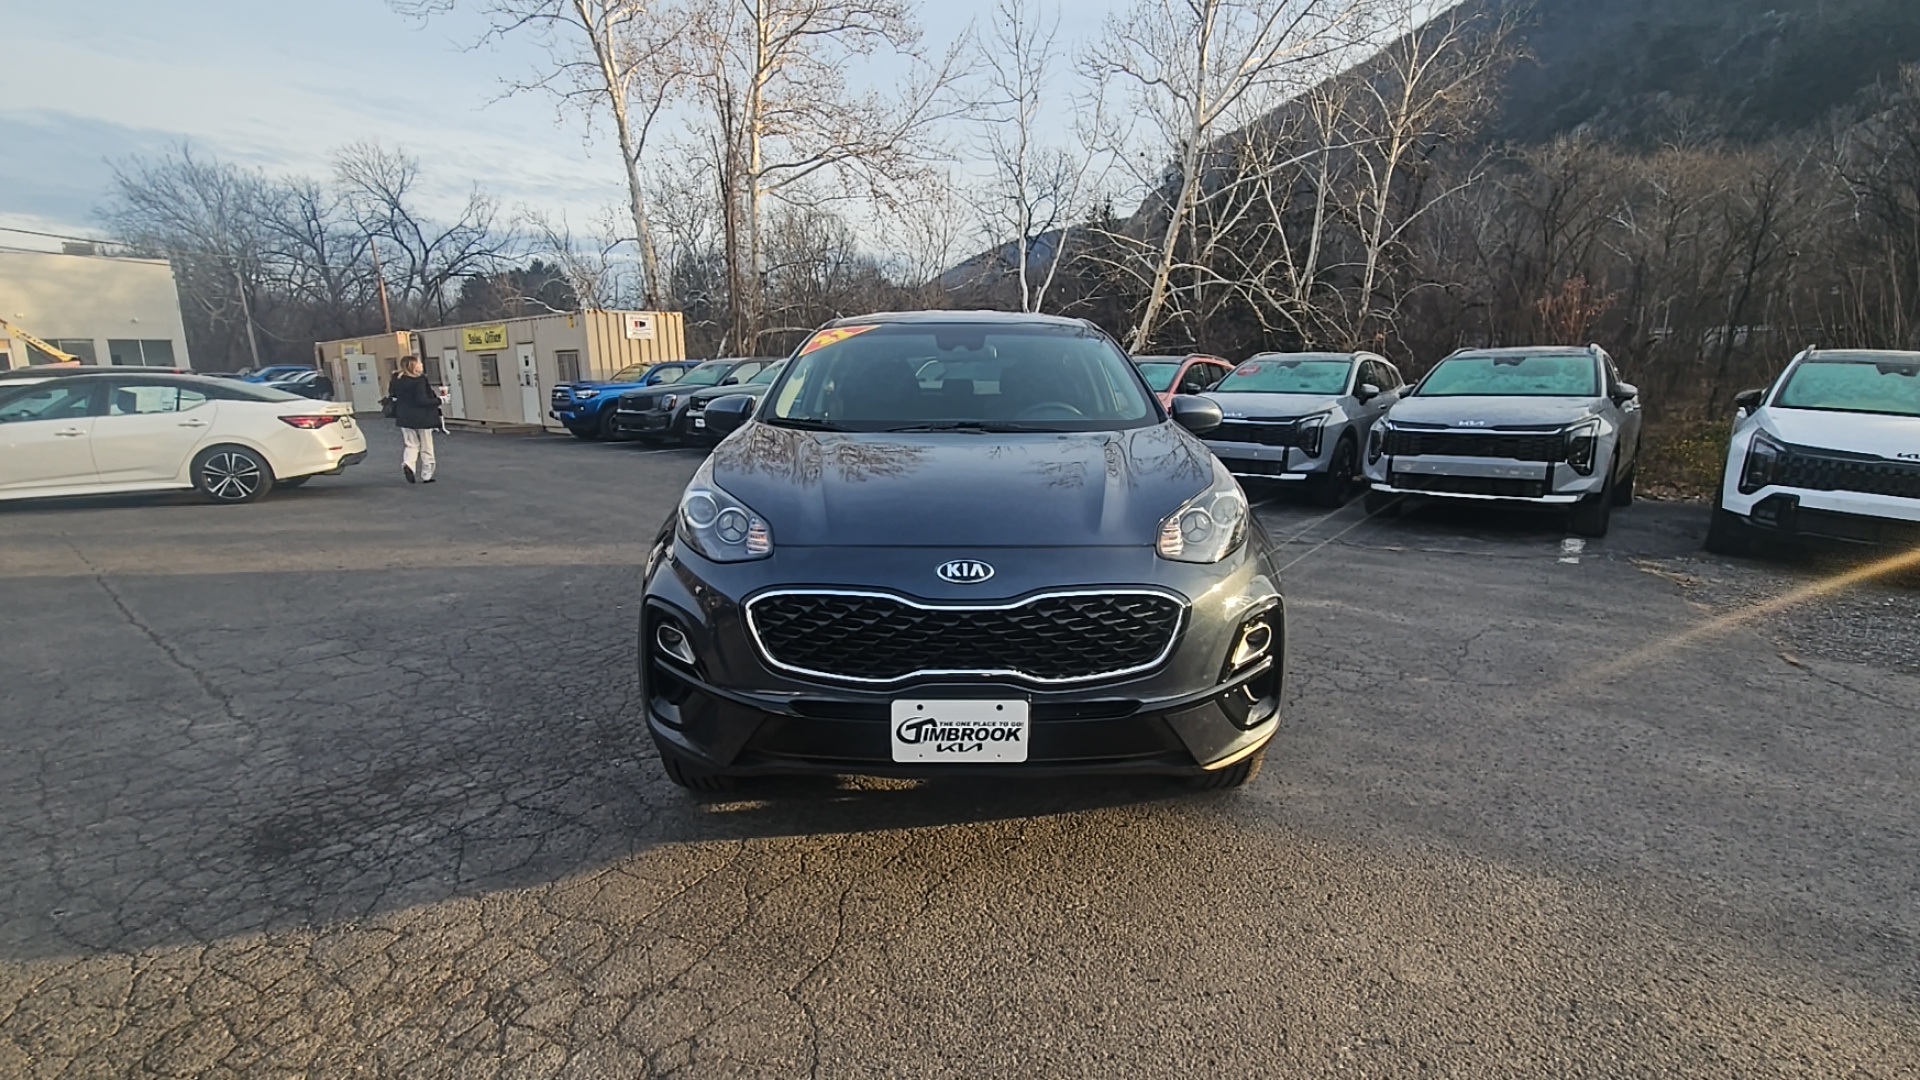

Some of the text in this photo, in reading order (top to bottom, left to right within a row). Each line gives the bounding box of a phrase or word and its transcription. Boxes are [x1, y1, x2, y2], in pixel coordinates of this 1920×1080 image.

[468, 331, 501, 344] Sales Office
[1896, 452, 1920, 460] KI
[946, 562, 985, 577] KIA
[896, 716, 1022, 744] TIMBROOK
[936, 742, 983, 752] KIA
